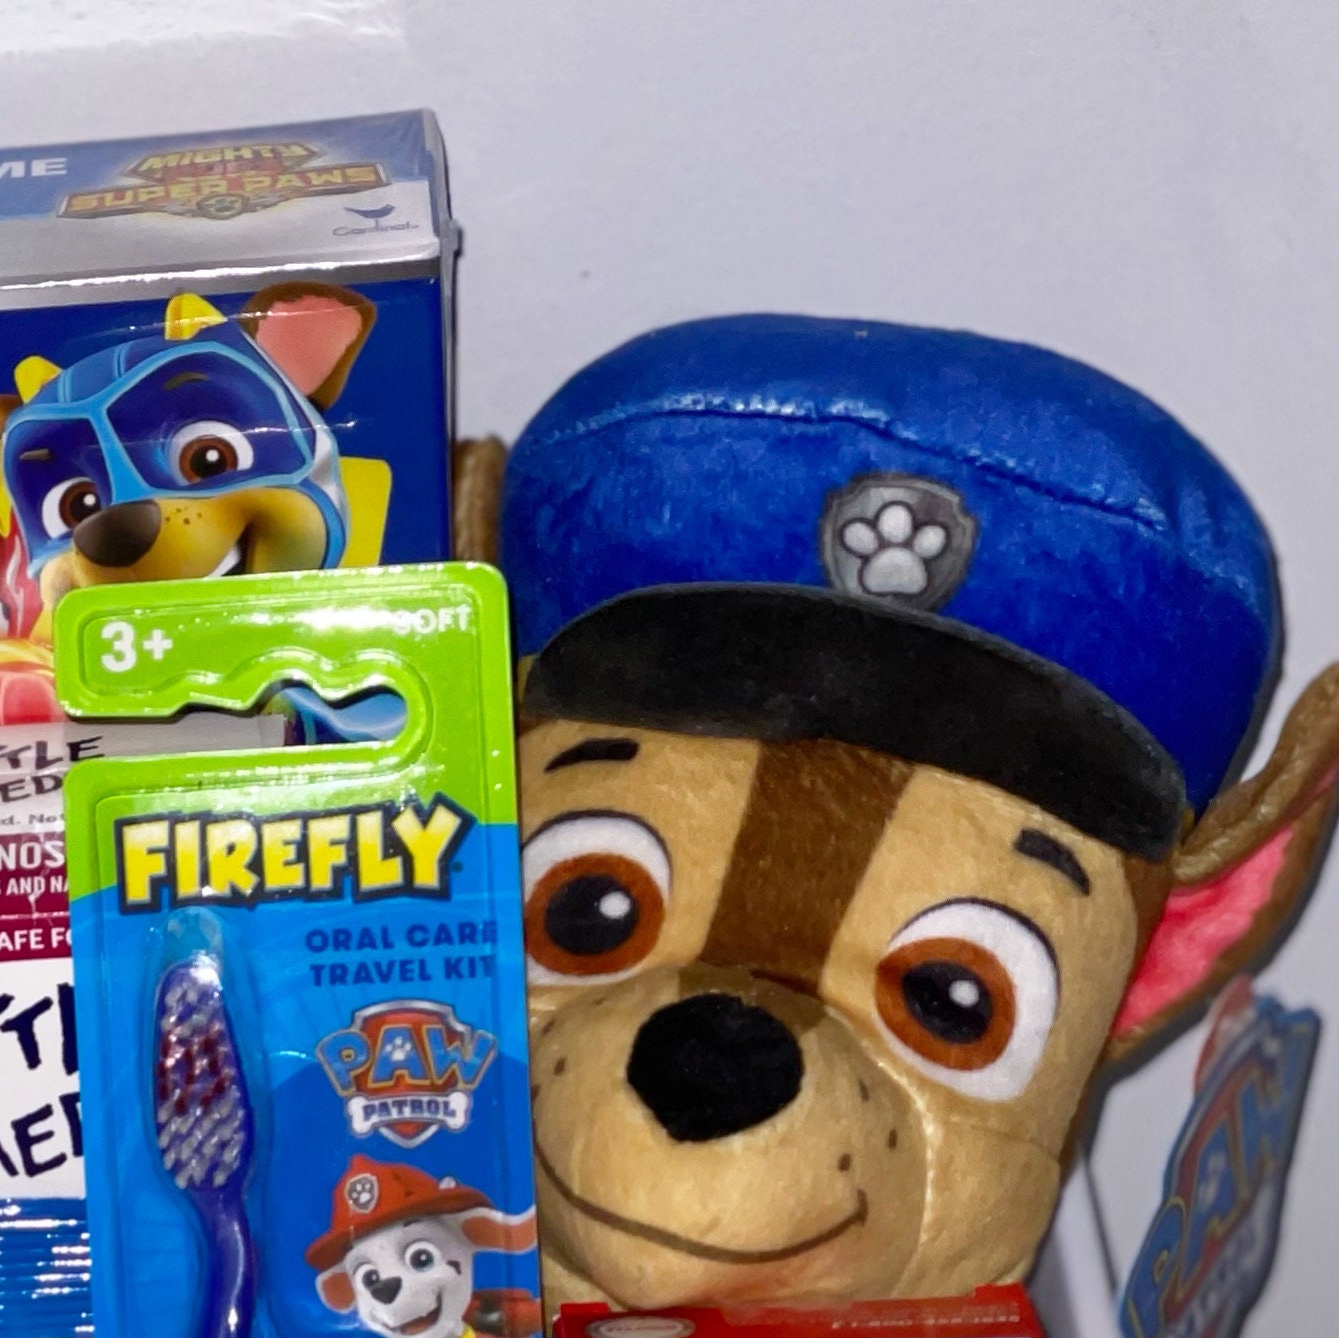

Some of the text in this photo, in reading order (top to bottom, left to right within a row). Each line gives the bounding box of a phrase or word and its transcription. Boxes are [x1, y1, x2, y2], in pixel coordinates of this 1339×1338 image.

[69, 175, 229, 211] SUPER
[246, 165, 377, 192] PAWS
[99, 620, 174, 673] 3+
[118, 798, 468, 909] FIREFLY
[6, 875, 46, 896] AND
[305, 919, 498, 954] ORAL CARE
[310, 954, 498, 988] TRAVEL KIT
[316, 1022, 499, 1098] PAW
[361, 1098, 458, 1122] PATROL
